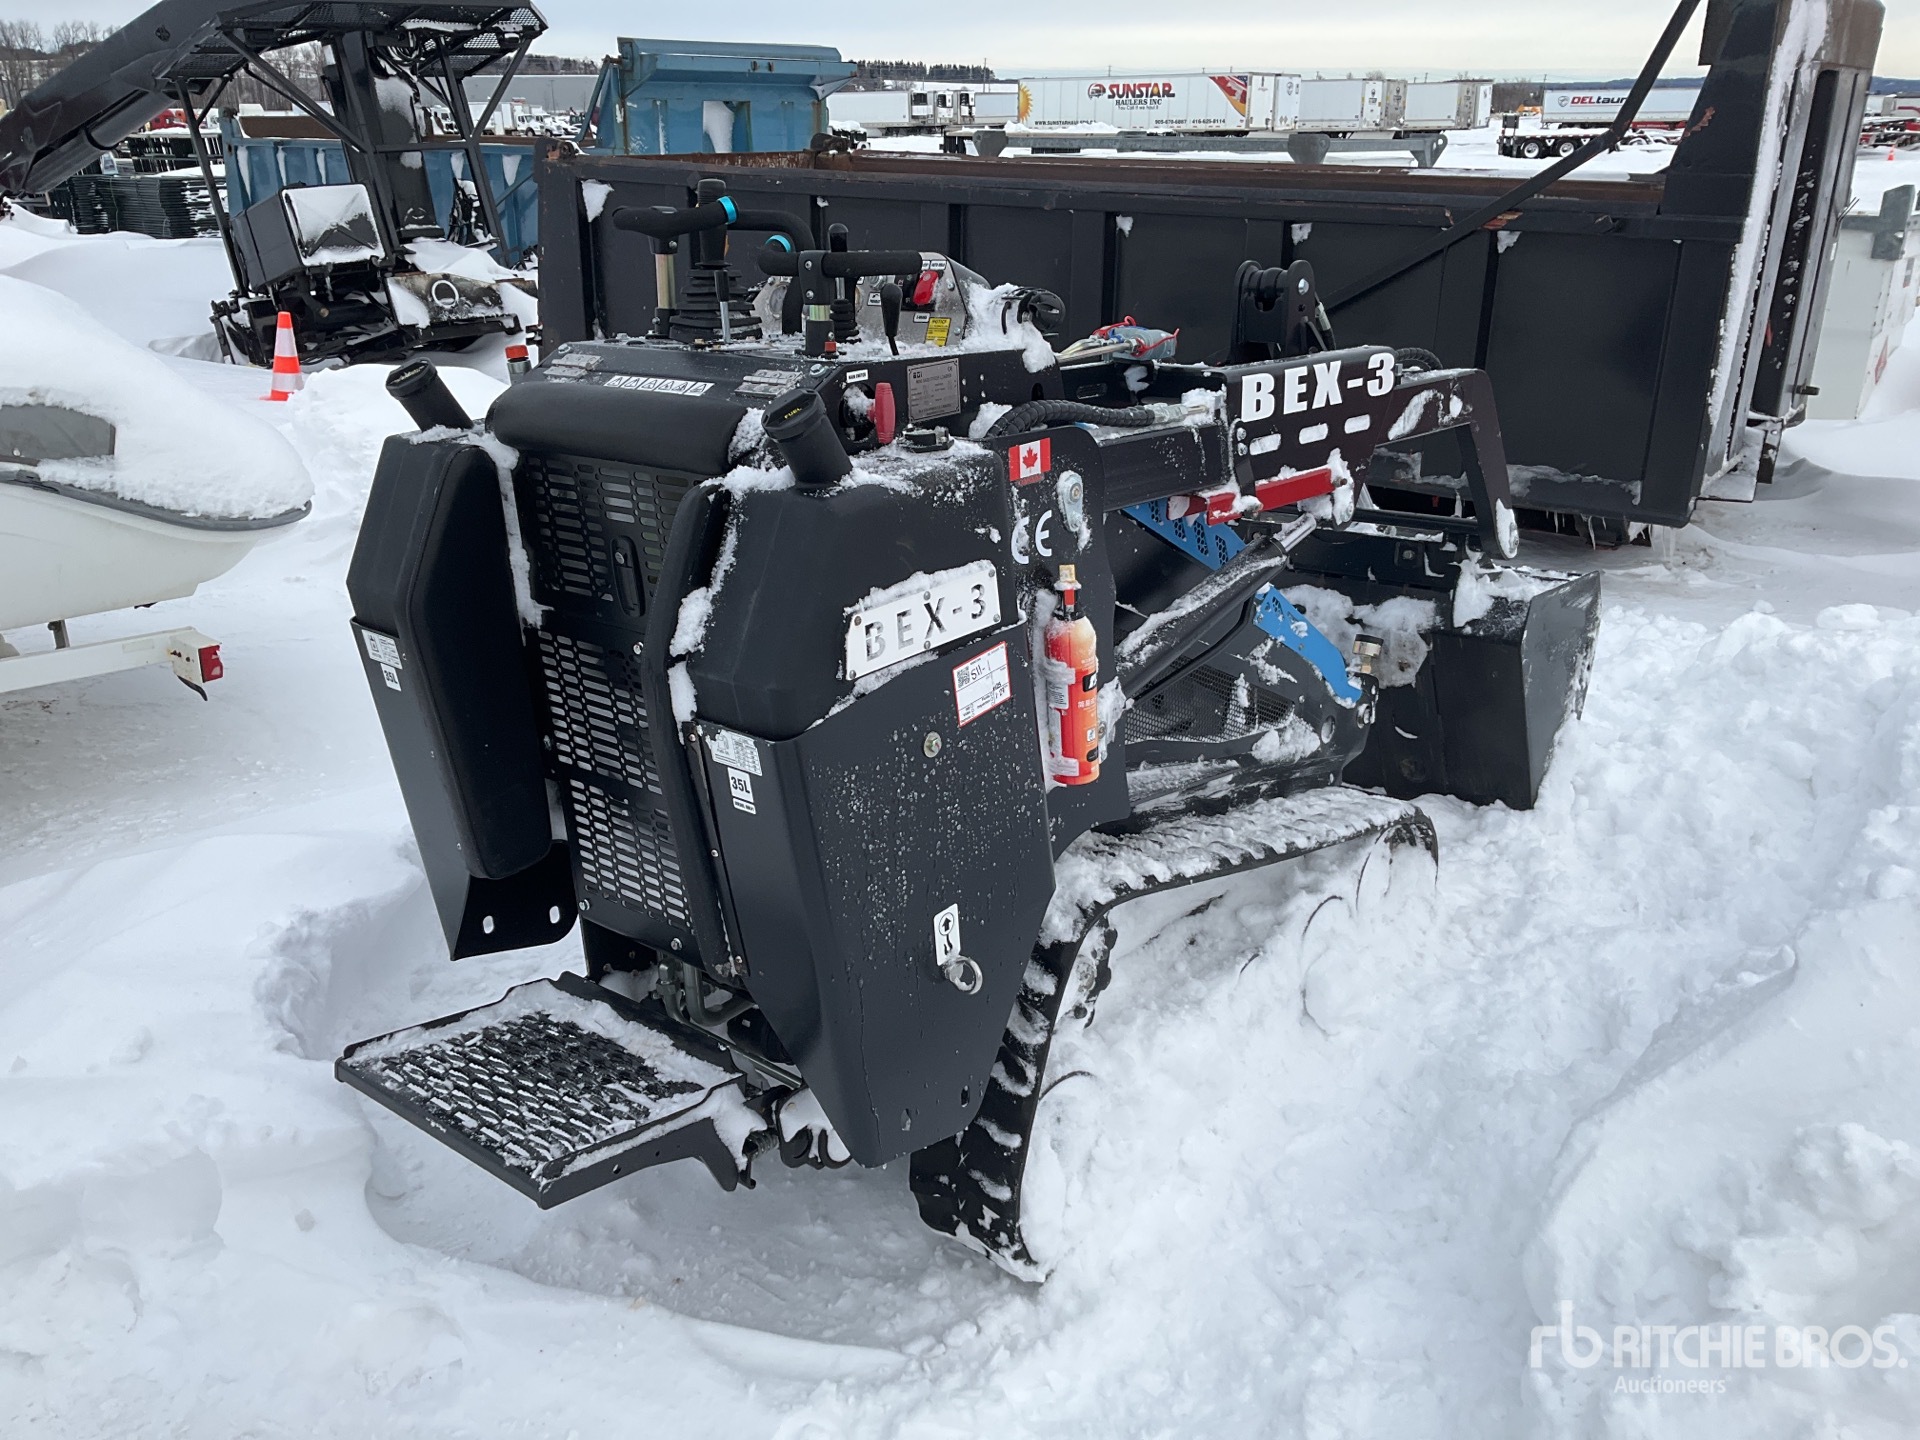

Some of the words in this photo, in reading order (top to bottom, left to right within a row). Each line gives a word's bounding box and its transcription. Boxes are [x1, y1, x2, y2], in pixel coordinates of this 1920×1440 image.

[1107, 82, 1175, 99] SUNSTAR
[1241, 352, 1395, 422] BEX-3
[783, 407, 802, 420] FUEL
[864, 583, 986, 662] BEX-3
[730, 776, 751, 794] 35L
